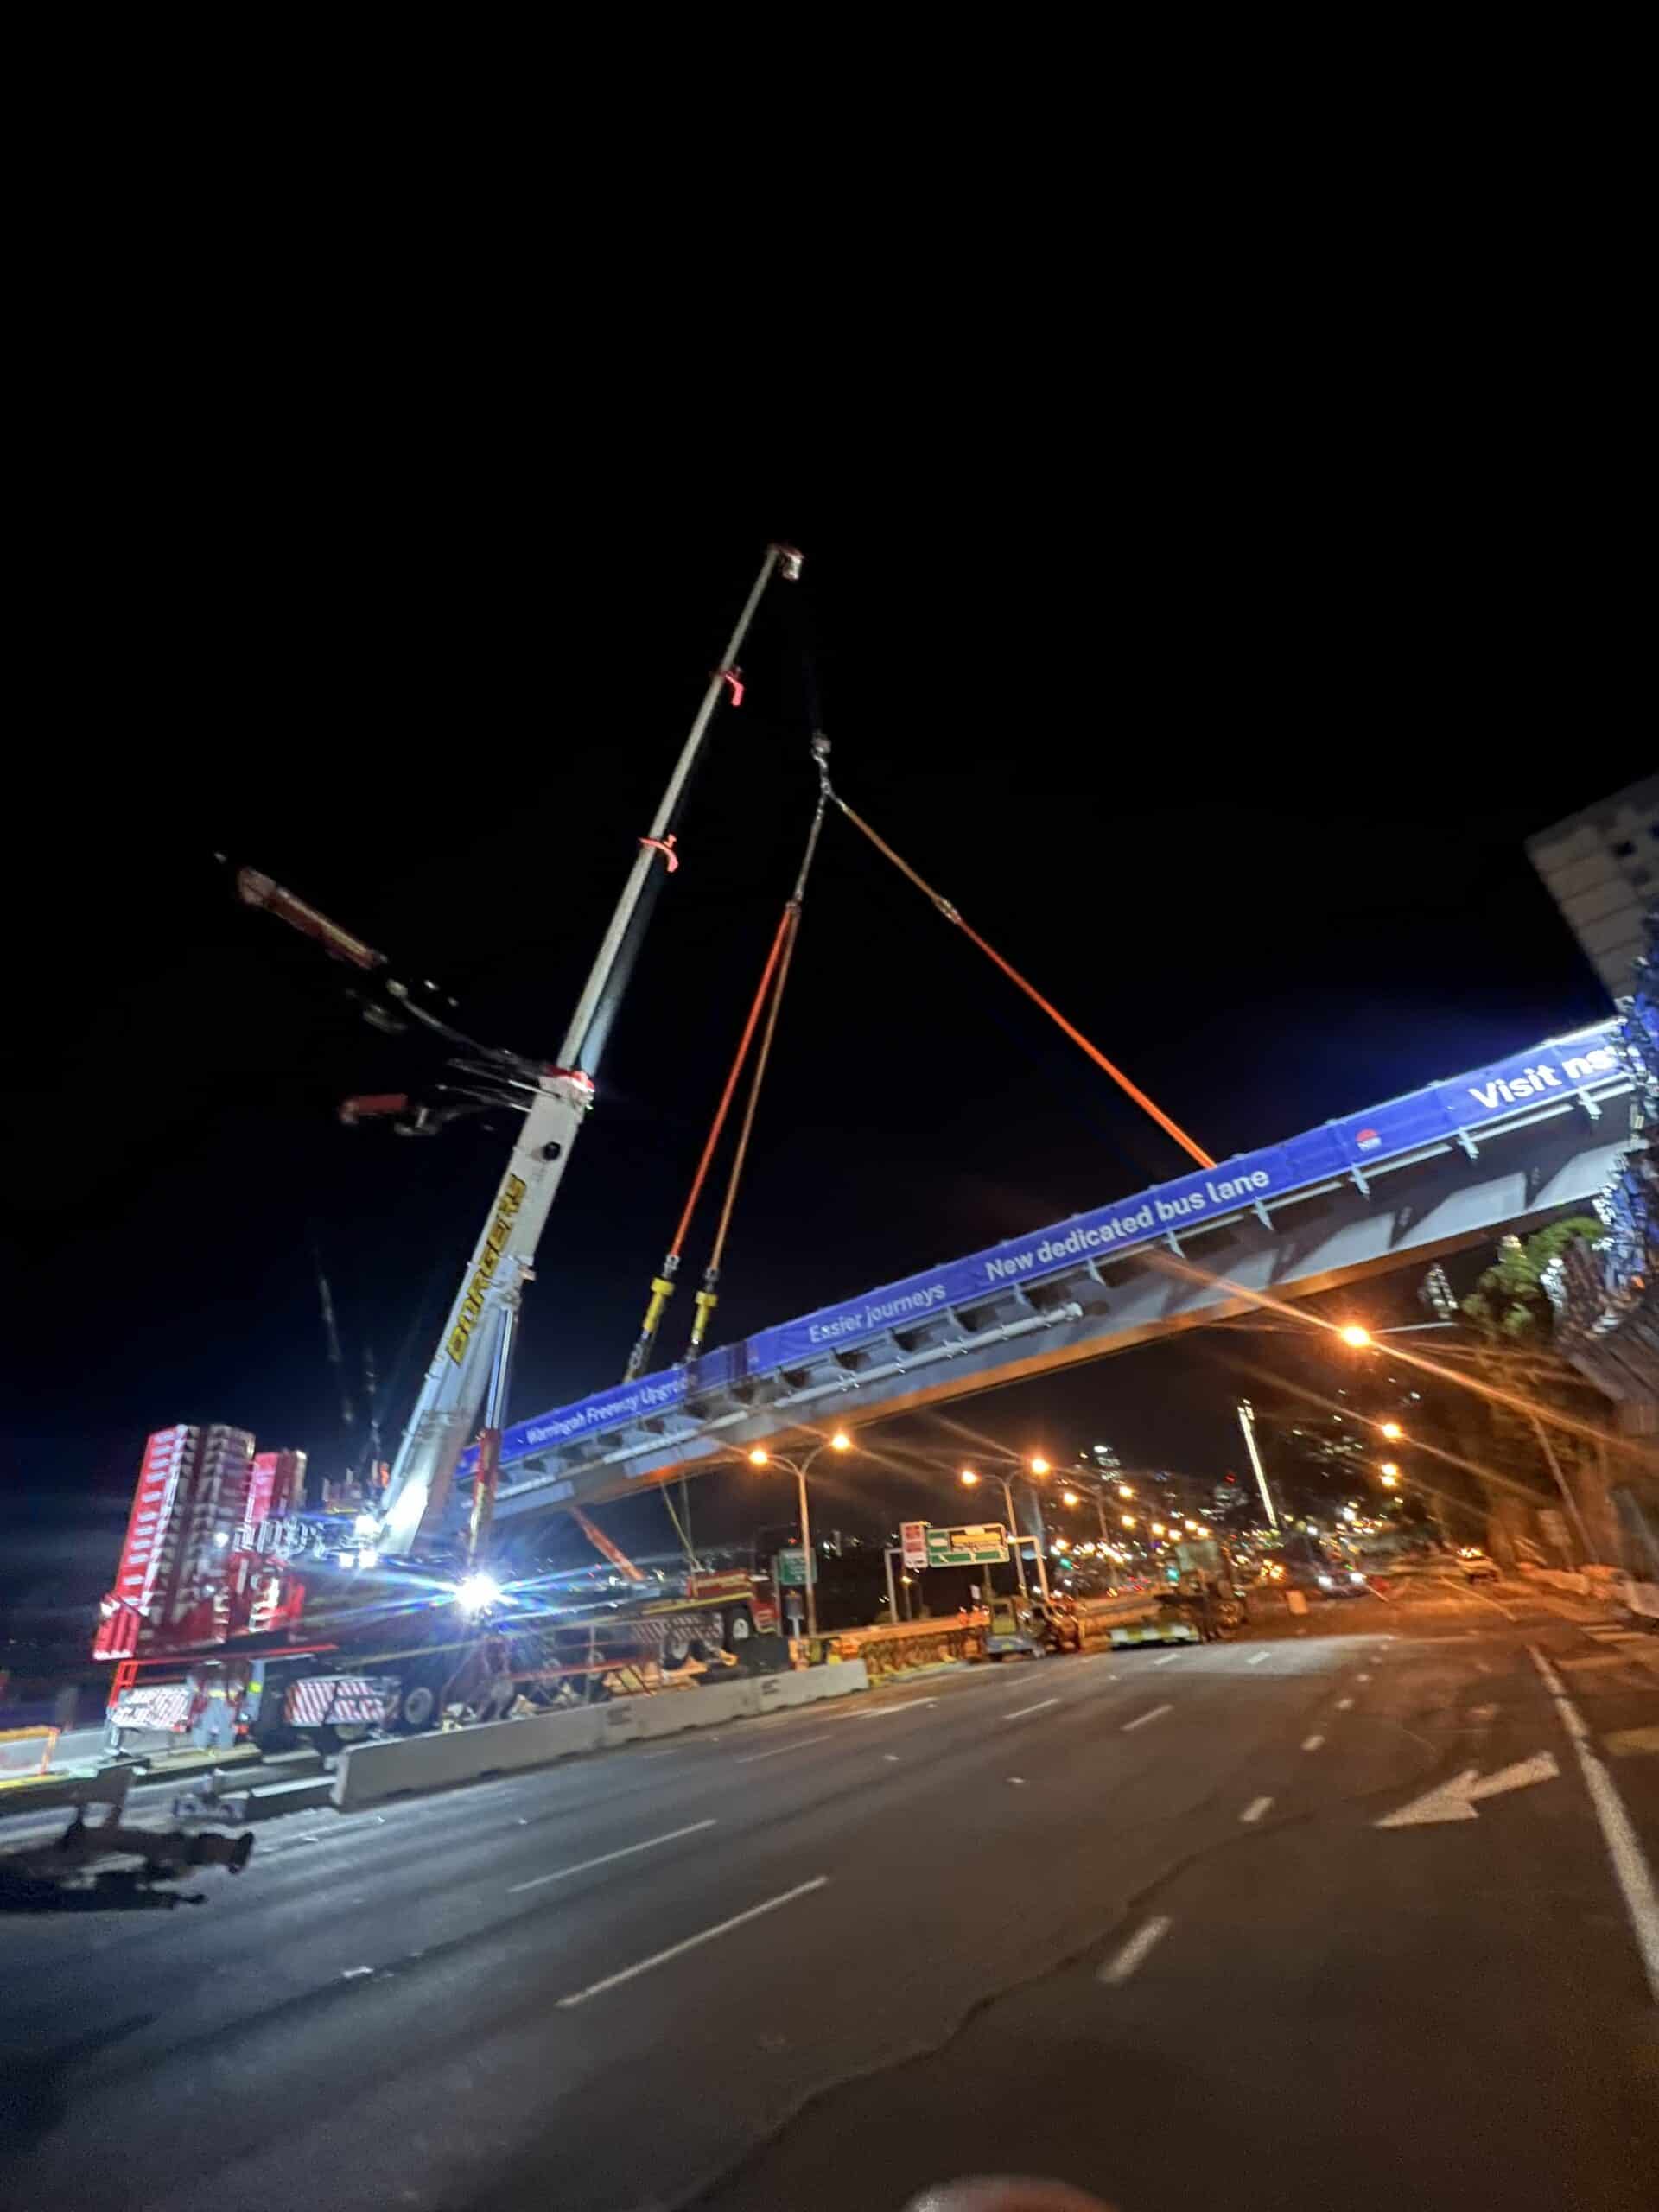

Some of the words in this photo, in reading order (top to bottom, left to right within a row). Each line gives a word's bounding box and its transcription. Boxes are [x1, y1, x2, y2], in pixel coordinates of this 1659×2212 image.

[1468, 1064, 1562, 1108] Visit
[985, 1252, 1033, 1281] New
[1037, 1205, 1154, 1264] dedicated
[1154, 1191, 1206, 1221] bus
[1206, 1170, 1270, 1203] lane
[864, 1284, 947, 1328] journeys
